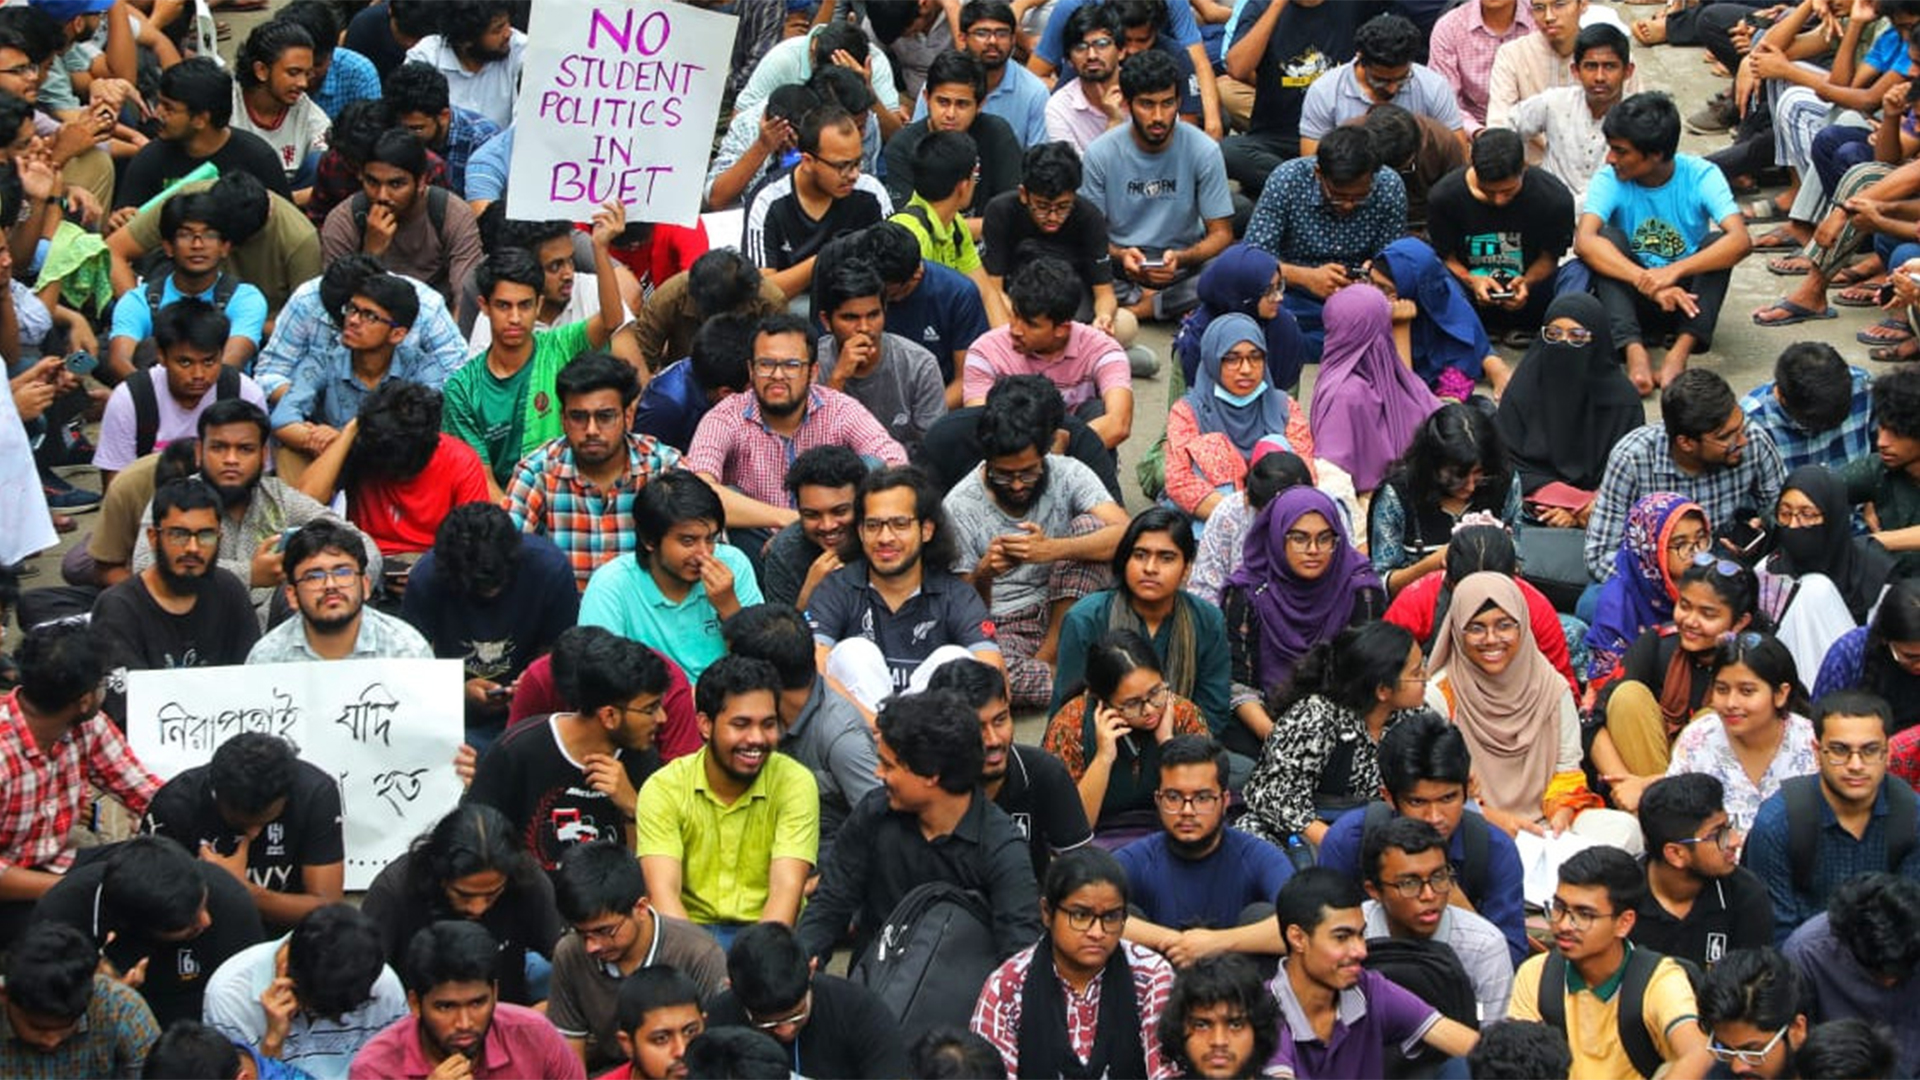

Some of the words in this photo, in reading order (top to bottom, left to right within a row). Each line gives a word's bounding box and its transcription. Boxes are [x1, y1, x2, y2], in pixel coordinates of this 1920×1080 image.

[587, 8, 670, 56] NO
[555, 54, 706, 95] STUDENT
[539, 91, 682, 128] POLITICS
[588, 135, 633, 166] IN
[550, 162, 673, 205] BUET
[335, 683, 400, 746] যদি
